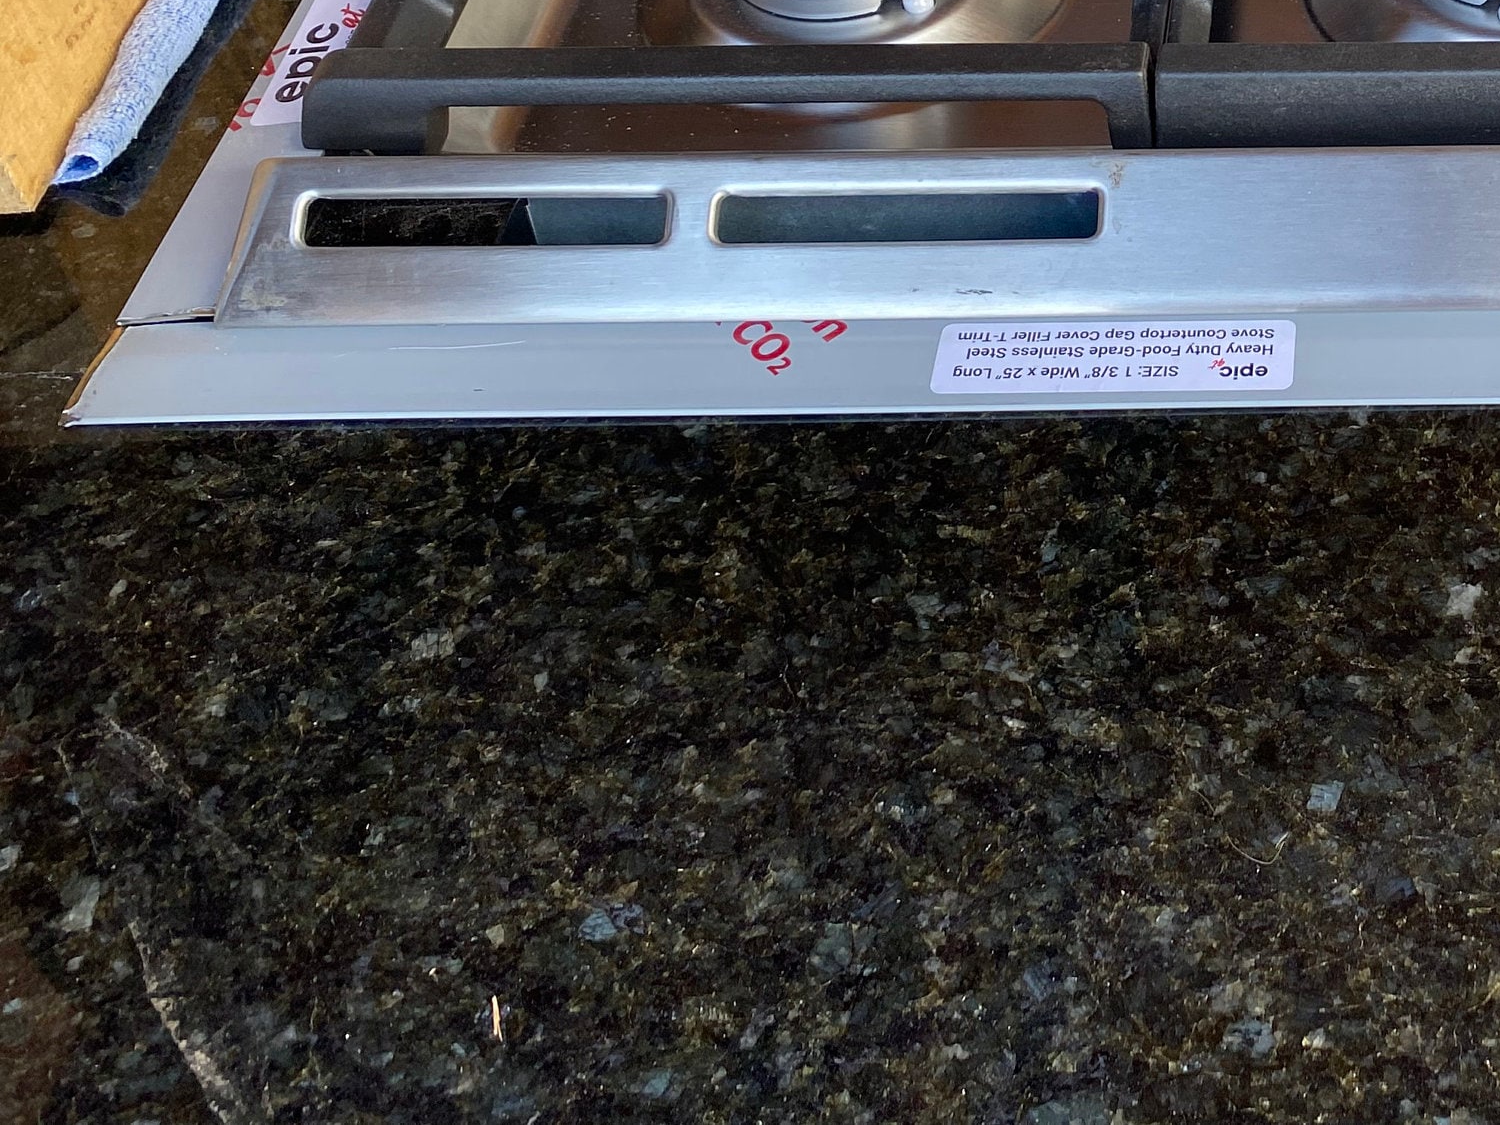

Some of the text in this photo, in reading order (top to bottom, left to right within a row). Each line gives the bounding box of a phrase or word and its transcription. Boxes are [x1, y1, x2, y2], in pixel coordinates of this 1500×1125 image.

[275, 22, 339, 103] epic
[957, 328, 1275, 343] Stove Countertop Gap Cover Filler T-Trim
[966, 342, 1274, 359] Heavy Duty Food-Grade Stainless Steel
[952, 365, 1179, 379] SIZE: 1 3/8" Wide x 25" Long
[1219, 363, 1268, 380] epic
